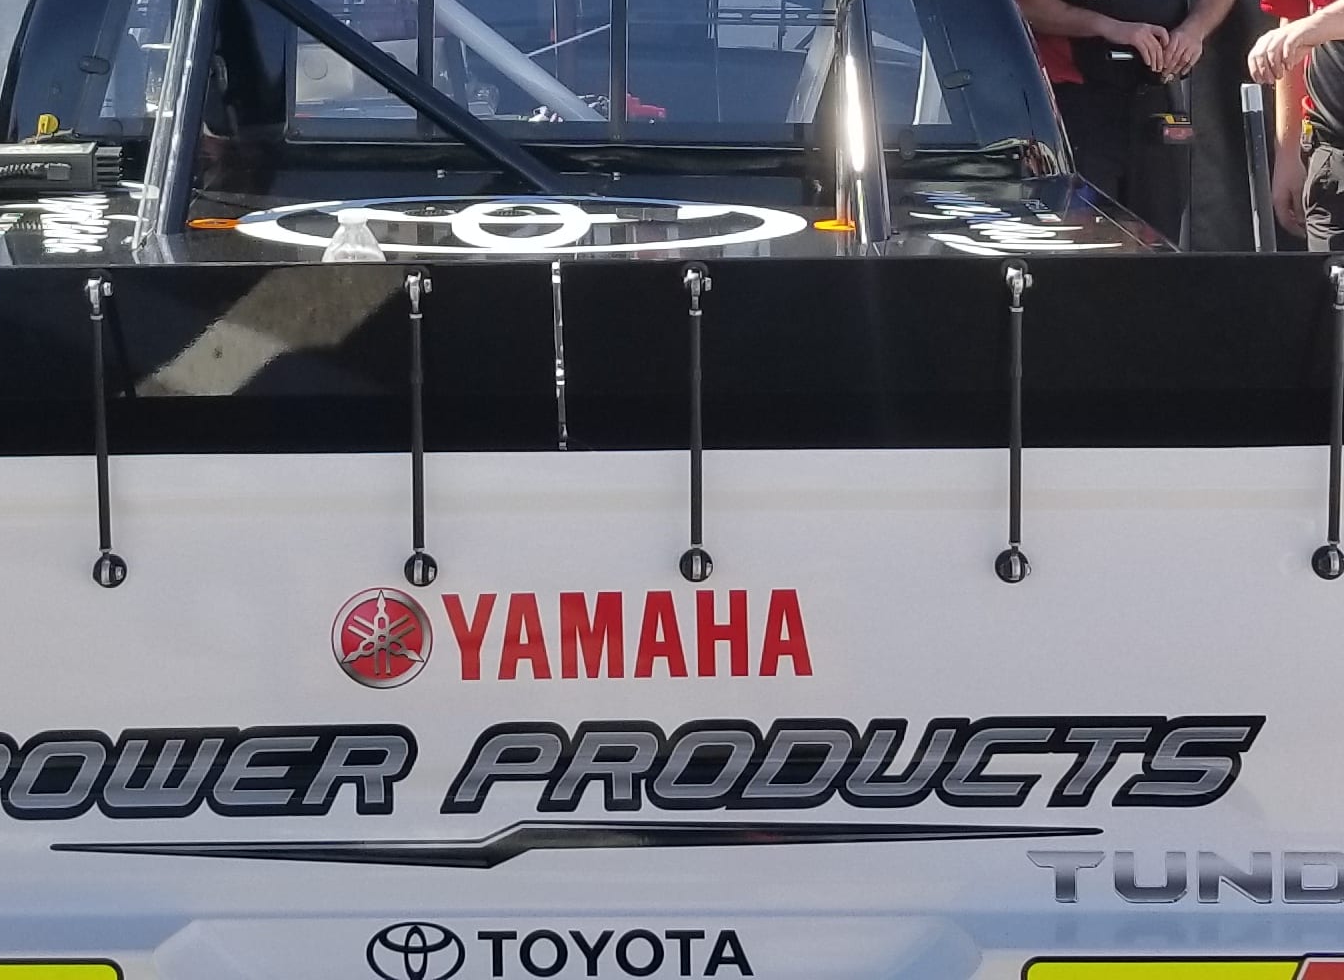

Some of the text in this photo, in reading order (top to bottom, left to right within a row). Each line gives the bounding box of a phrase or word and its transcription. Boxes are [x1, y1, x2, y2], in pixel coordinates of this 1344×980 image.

[442, 588, 814, 681] YAMAHA
[439, 715, 1267, 816] PRODUCTS
[477, 929, 755, 978] TOYOTA
